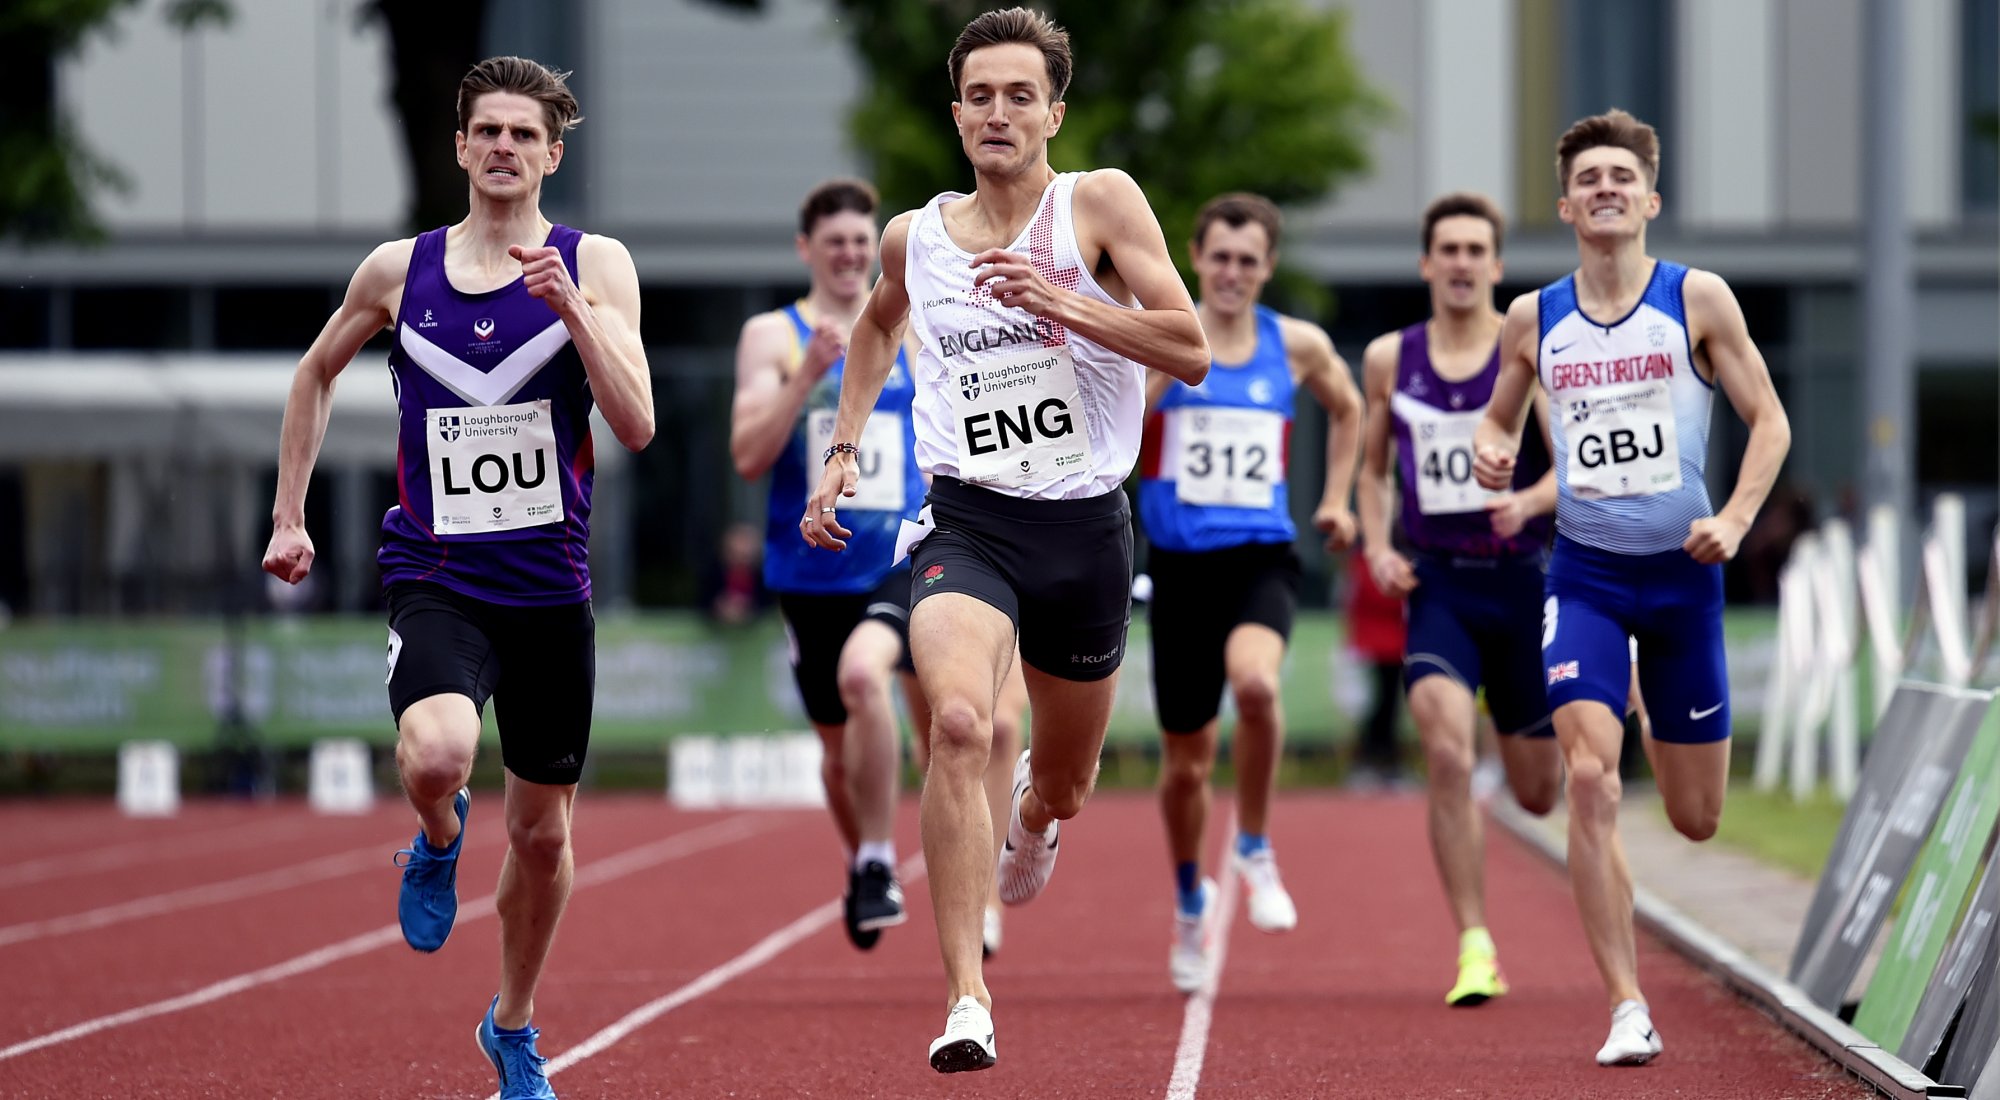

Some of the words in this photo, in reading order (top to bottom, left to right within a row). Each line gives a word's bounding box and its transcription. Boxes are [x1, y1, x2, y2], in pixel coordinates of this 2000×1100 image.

[926, 297, 955, 308] KUKRI
[982, 357, 1058, 383] Loughborough
[1552, 362, 1603, 390] GREAT
[984, 375, 1037, 393] University
[464, 410, 539, 426] Loughborough
[465, 425, 518, 438] University
[964, 398, 1074, 457] ENG
[1578, 424, 1664, 468] GBJ
[441, 448, 546, 496] LOU
[1187, 444, 1267, 481] 312
[1423, 447, 1472, 485] 40
[1082, 645, 1119, 664] KUKRI
